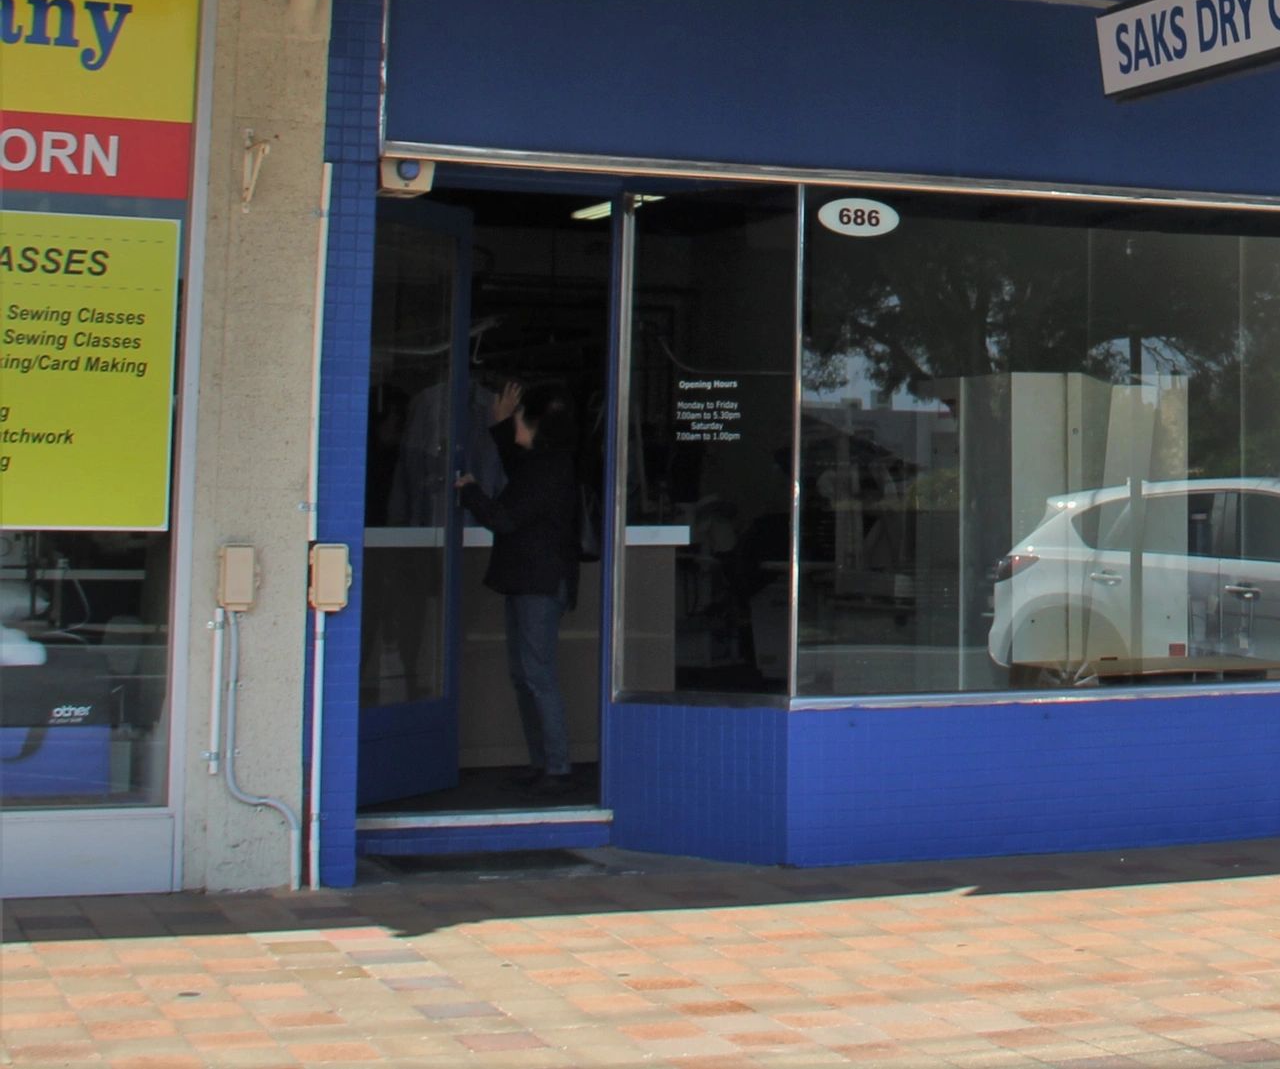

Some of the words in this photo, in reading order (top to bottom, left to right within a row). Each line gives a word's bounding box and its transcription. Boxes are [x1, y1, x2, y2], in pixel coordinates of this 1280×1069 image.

[1115, 6, 1188, 75] SAKS
[838, 207, 881, 227] 686
[7, 304, 72, 326] Sewing
[77, 307, 146, 325] Classes
[3, 328, 68, 350] Sewing
[73, 332, 142, 349] Classes
[84, 356, 148, 378] Making
[679, 380, 712, 390] Opening
[713, 380, 738, 388] Hours
[677, 401, 705, 410] Monday
[716, 400, 738, 410] Friday
[0, 428, 74, 444] tchwork
[691, 422, 723, 431] Saturday
